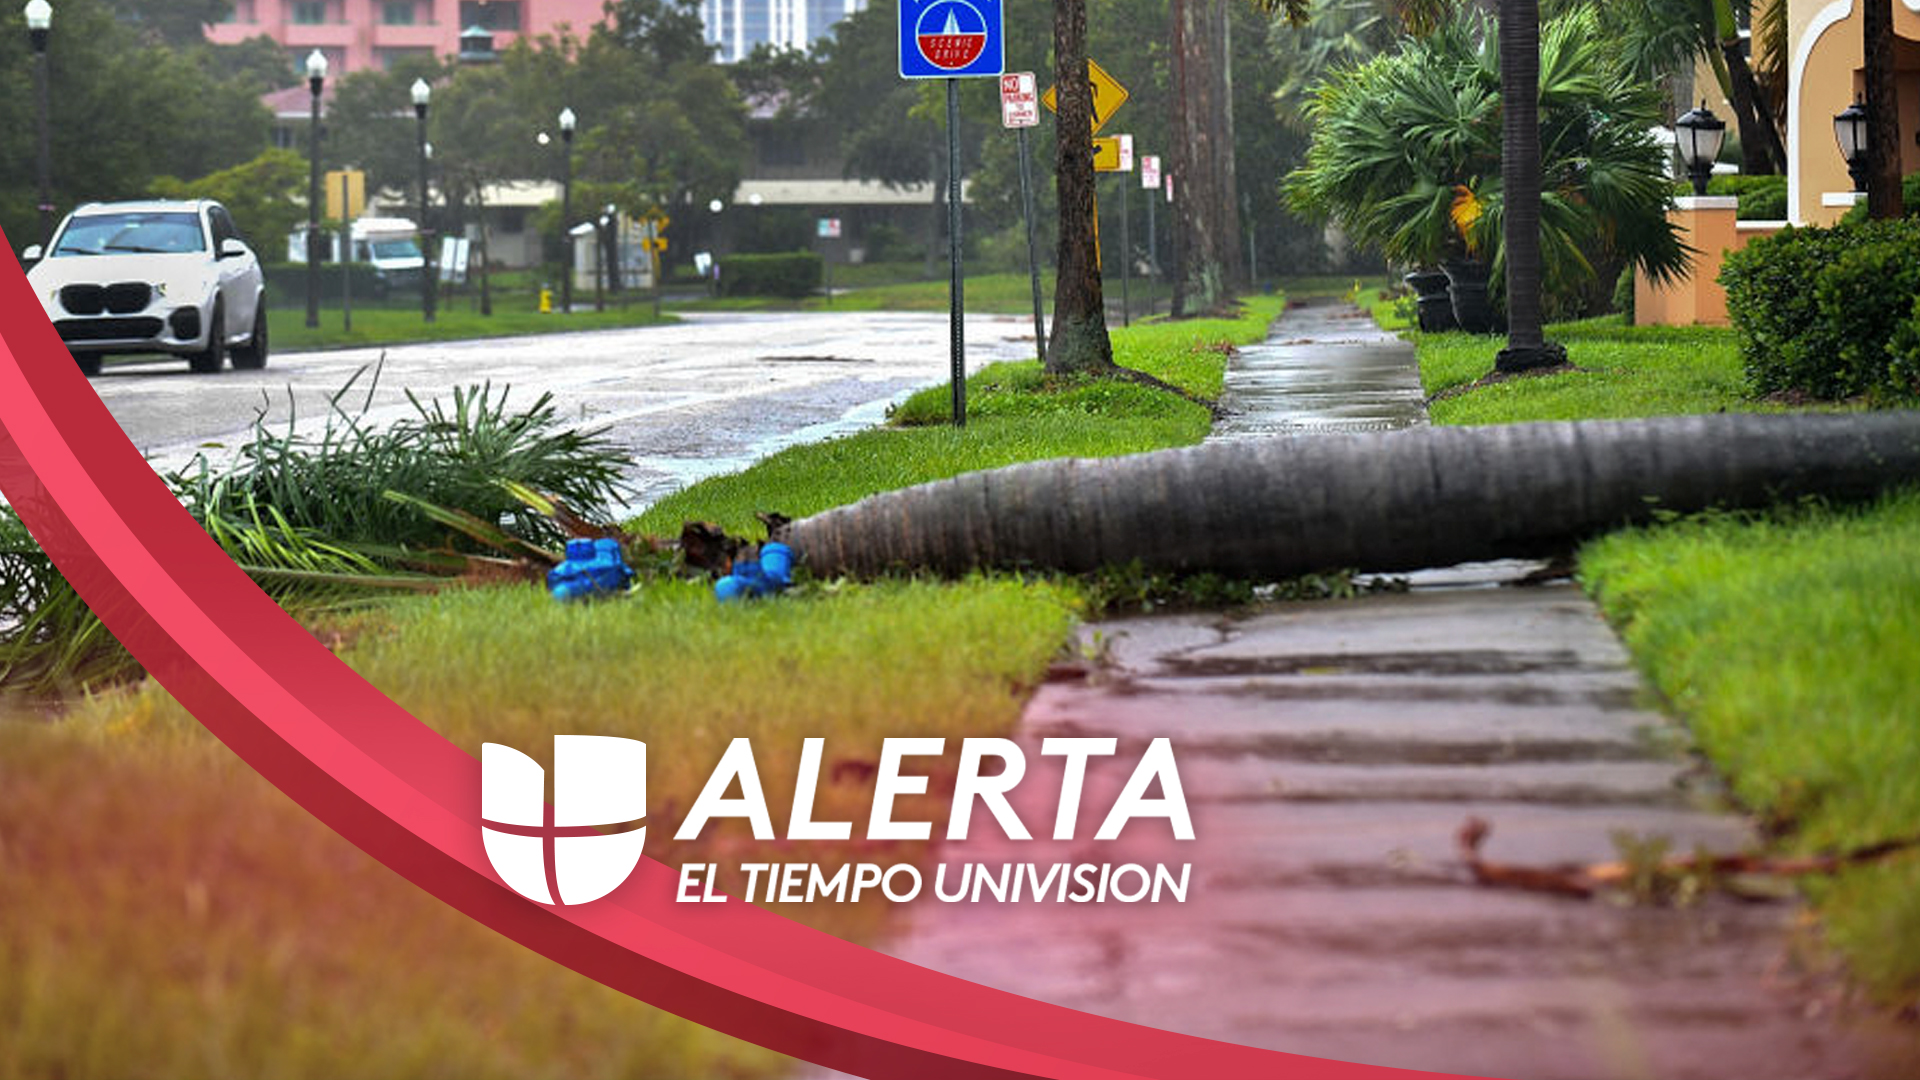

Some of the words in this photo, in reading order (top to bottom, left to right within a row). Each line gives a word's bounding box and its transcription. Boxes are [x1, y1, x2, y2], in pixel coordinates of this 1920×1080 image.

[930, 37, 973, 49] SCENIC
[935, 49, 969, 59] DRIVE
[1003, 77, 1019, 91] NO
